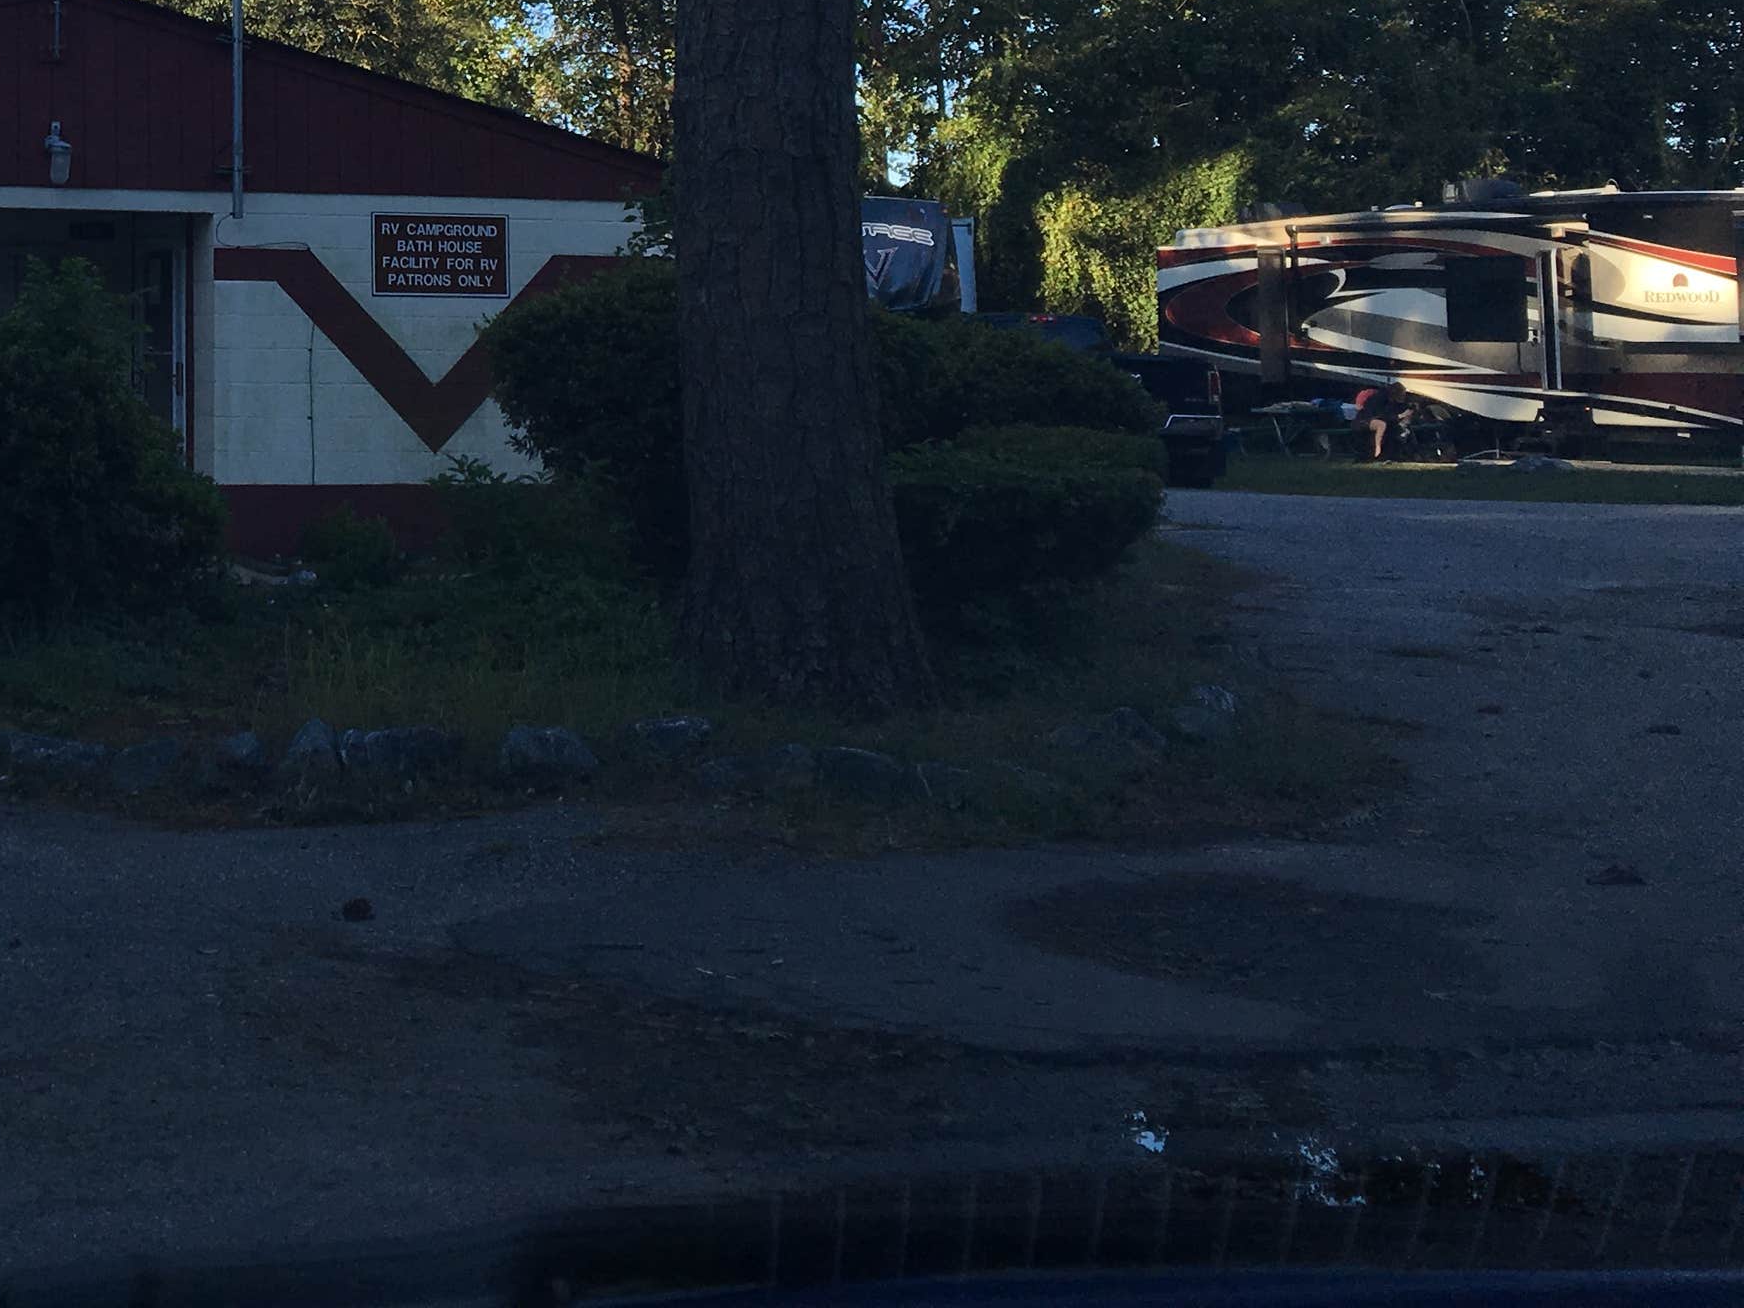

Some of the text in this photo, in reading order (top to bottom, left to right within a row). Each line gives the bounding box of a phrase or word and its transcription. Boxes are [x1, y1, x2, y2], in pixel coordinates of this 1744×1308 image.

[381, 222, 498, 237] RV CAMPGROUND
[397, 239, 483, 254] BATH HOUSE
[382, 256, 498, 270] FACILITY FOR RV
[387, 273, 494, 288] PATRONS ONLY
[1644, 290, 1720, 304] REDWOOD
